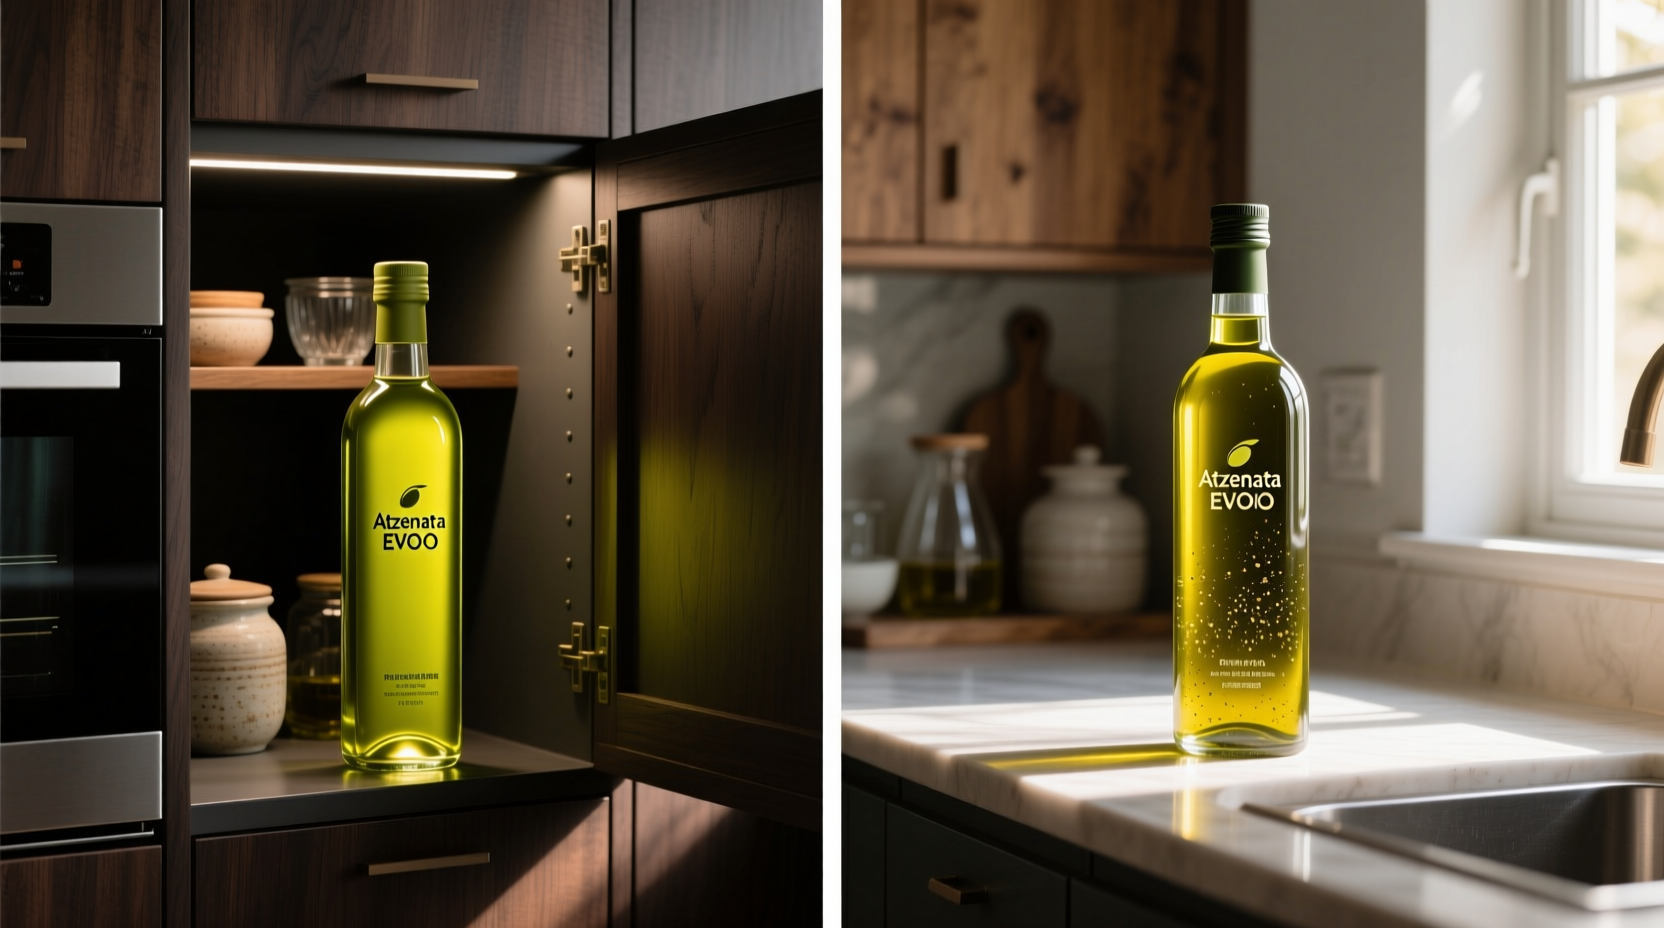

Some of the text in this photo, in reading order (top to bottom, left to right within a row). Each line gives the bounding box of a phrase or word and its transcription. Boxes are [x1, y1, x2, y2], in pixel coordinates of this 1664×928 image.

[1198, 469, 1282, 488] Atzenata
[373, 512, 445, 529] Atzenata
[383, 533, 438, 550] EVOO
